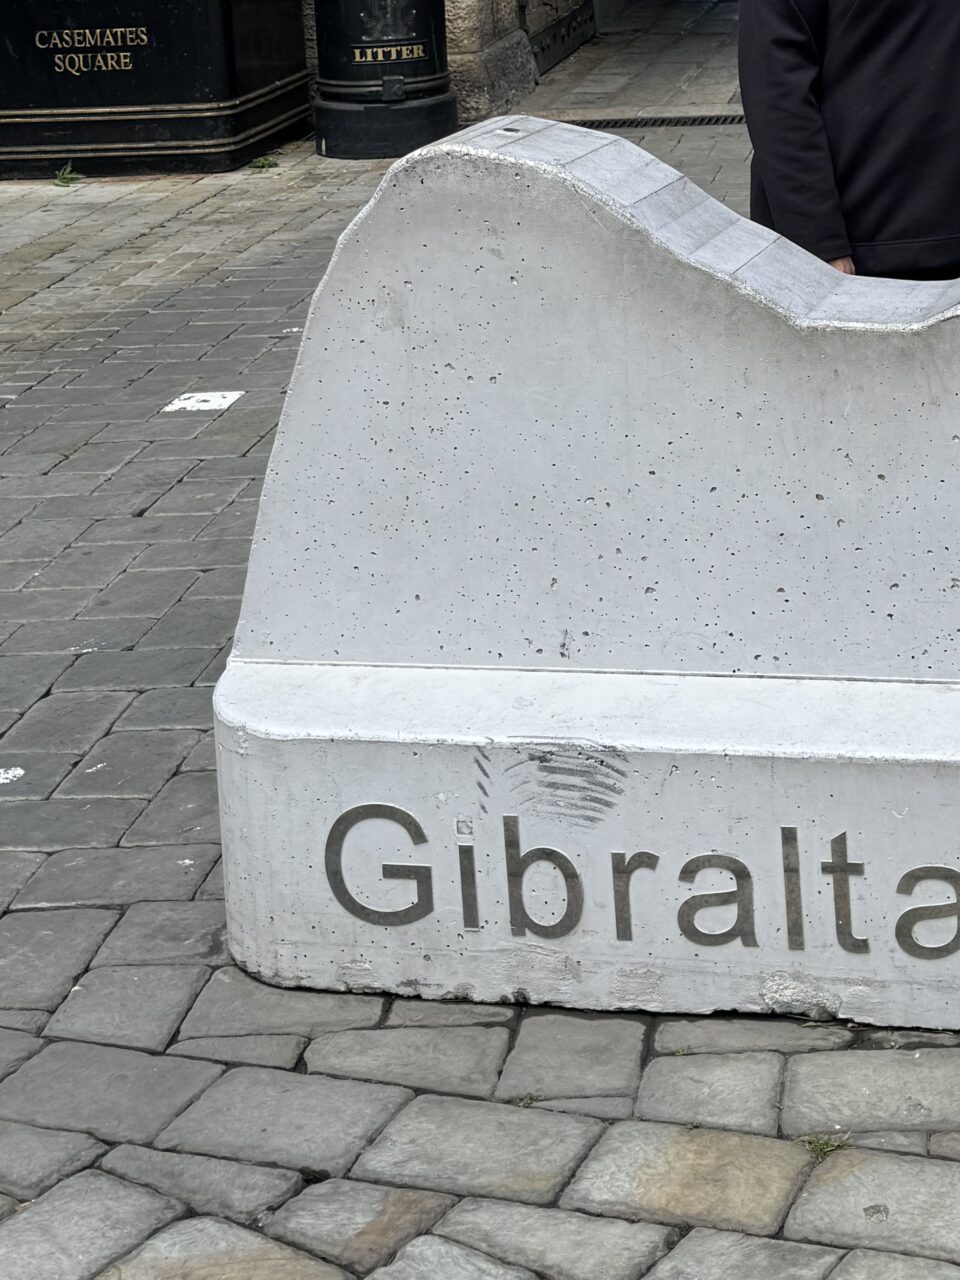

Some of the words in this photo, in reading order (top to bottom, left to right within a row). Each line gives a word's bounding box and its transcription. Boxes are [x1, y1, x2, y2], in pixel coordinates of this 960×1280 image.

[35, 27, 148, 49] CASEMATES
[54, 52, 133, 76] SQUARE
[353, 44, 425, 62] LITTER
